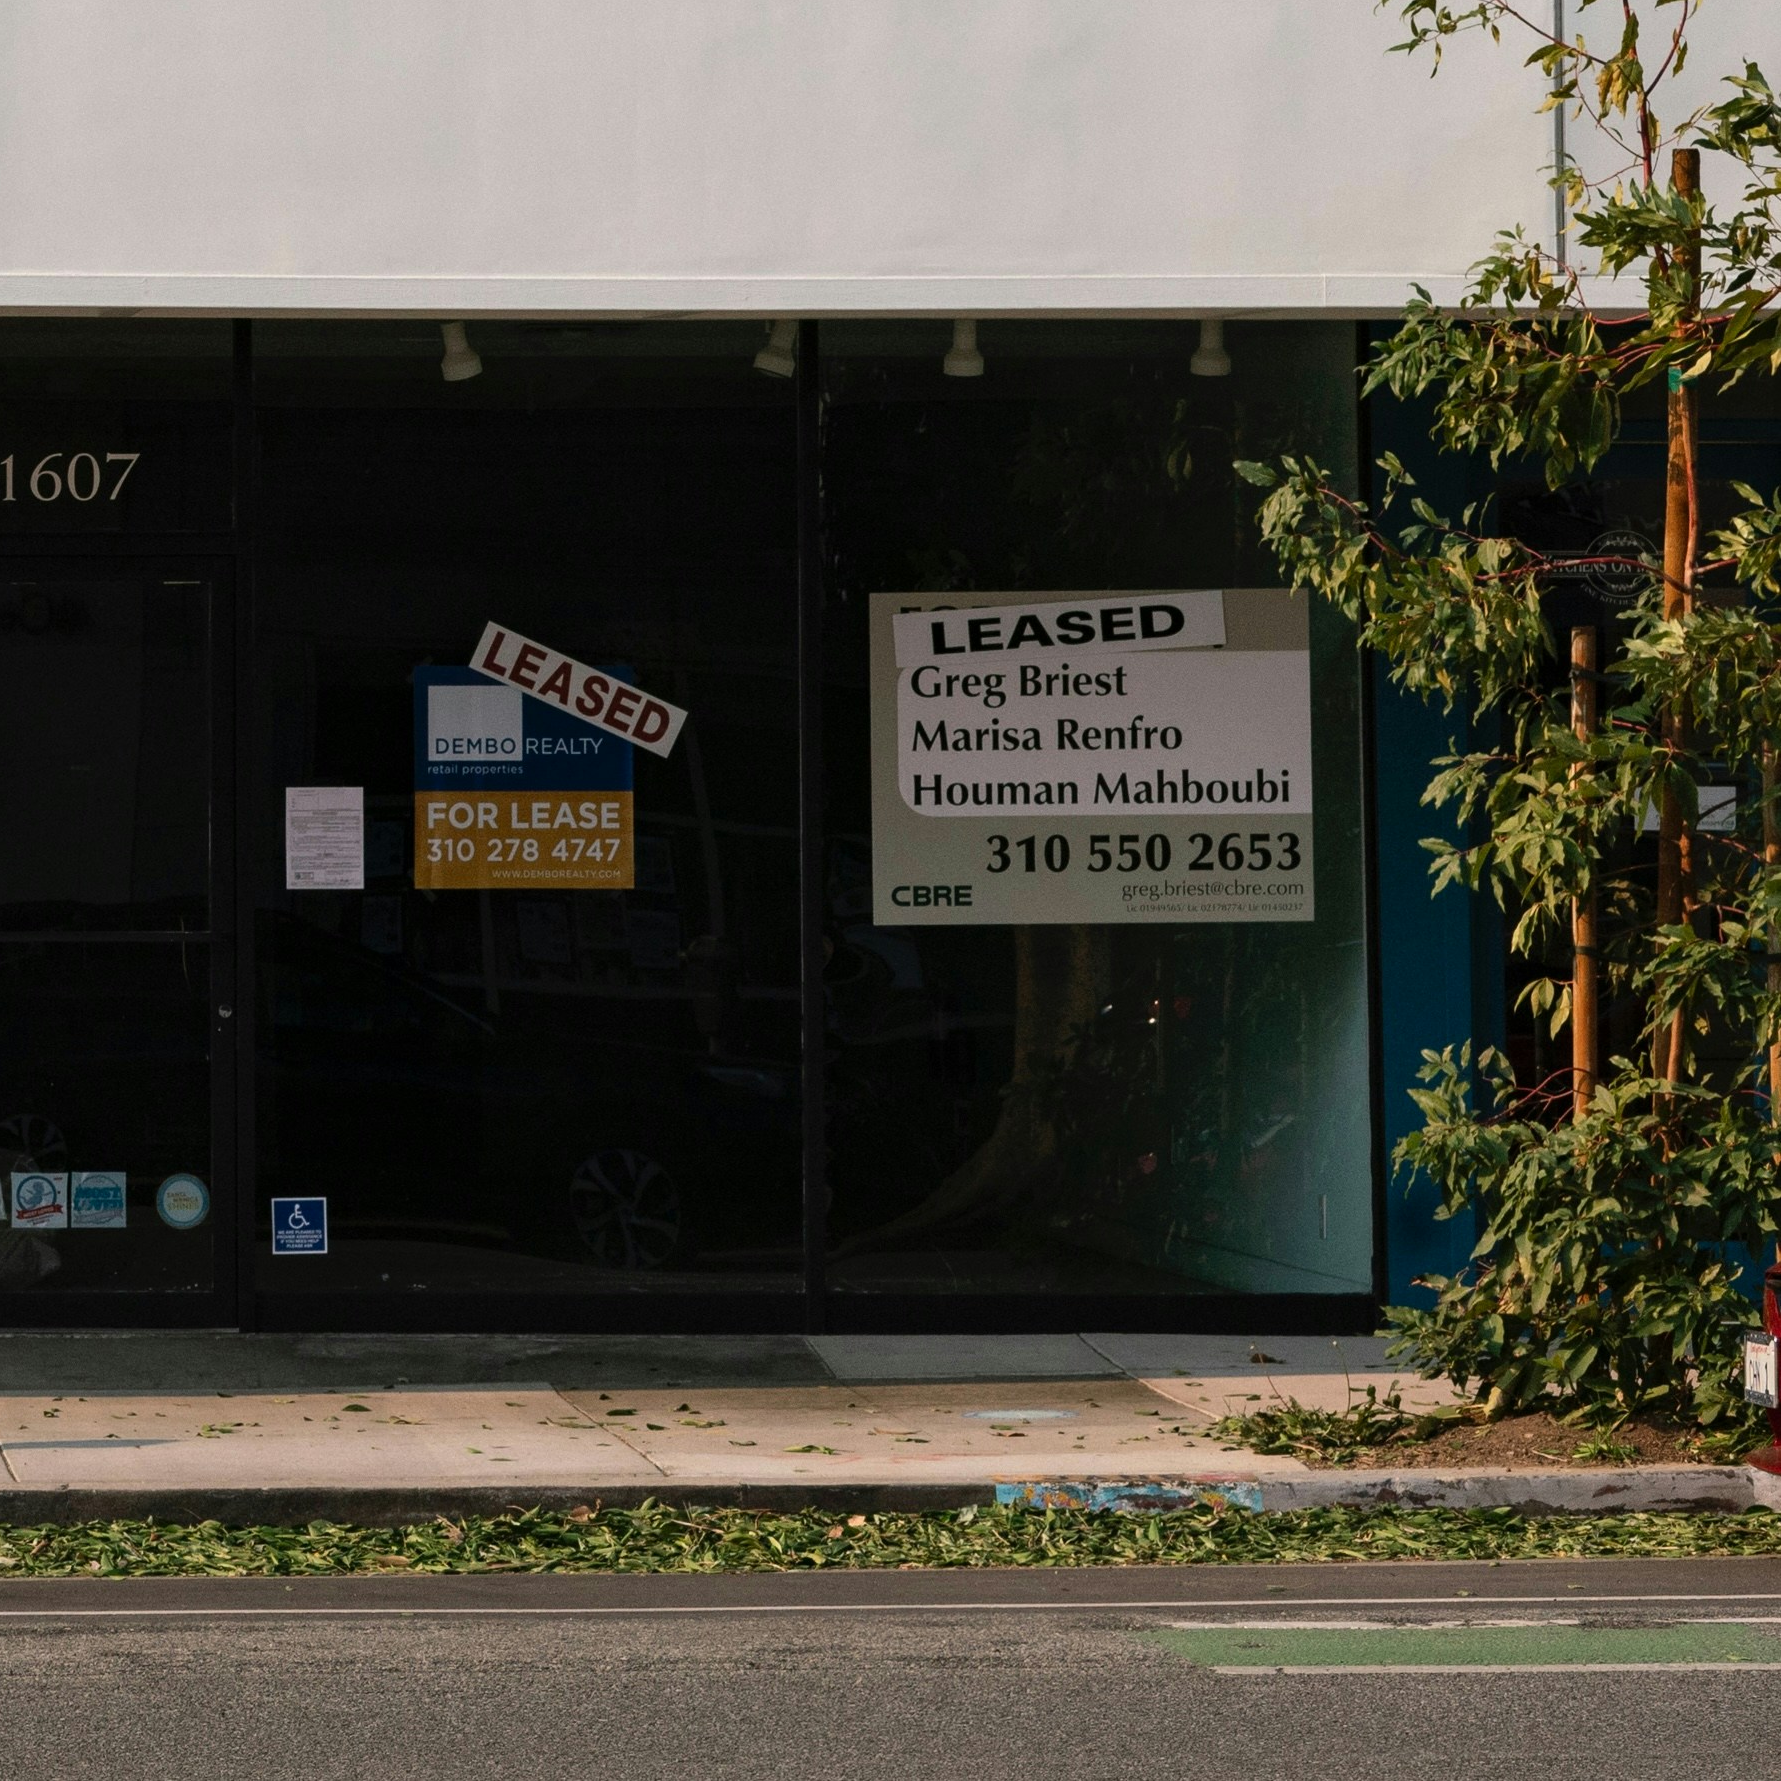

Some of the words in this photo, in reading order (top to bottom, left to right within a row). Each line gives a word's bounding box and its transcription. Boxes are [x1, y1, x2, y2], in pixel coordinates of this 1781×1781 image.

[0, 452, 141, 502] 1607
[931, 604, 1185, 655] LEASED
[482, 631, 671, 744] LEASED
[911, 665, 1007, 709] Greg
[1019, 664, 1128, 697] Briest
[435, 738, 516, 754] DEMBO
[526, 737, 604, 755] REALTY
[911, 718, 1043, 752] Marisa
[1057, 715, 1182, 751] Renfro
[427, 764, 458, 774] retail
[462, 764, 524, 776] properties
[913, 773, 1079, 806] Houman
[1094, 769, 1290, 805] Mahboubi
[428, 802, 498, 829] FOR
[511, 802, 620, 829] LEASE
[427, 838, 475, 862] 310
[487, 838, 539, 862] 278
[551, 838, 621, 862] 4747
[985, 834, 1070, 873] 310
[1087, 834, 1171, 872] 550
[1188, 832, 1301, 871] 2653
[492, 870, 621, 879] WWW.DEMBOREALTY.COM
[1122, 880, 1304, 901] greg.briest@cbre.com
[891, 885, 973, 906] CBRE
